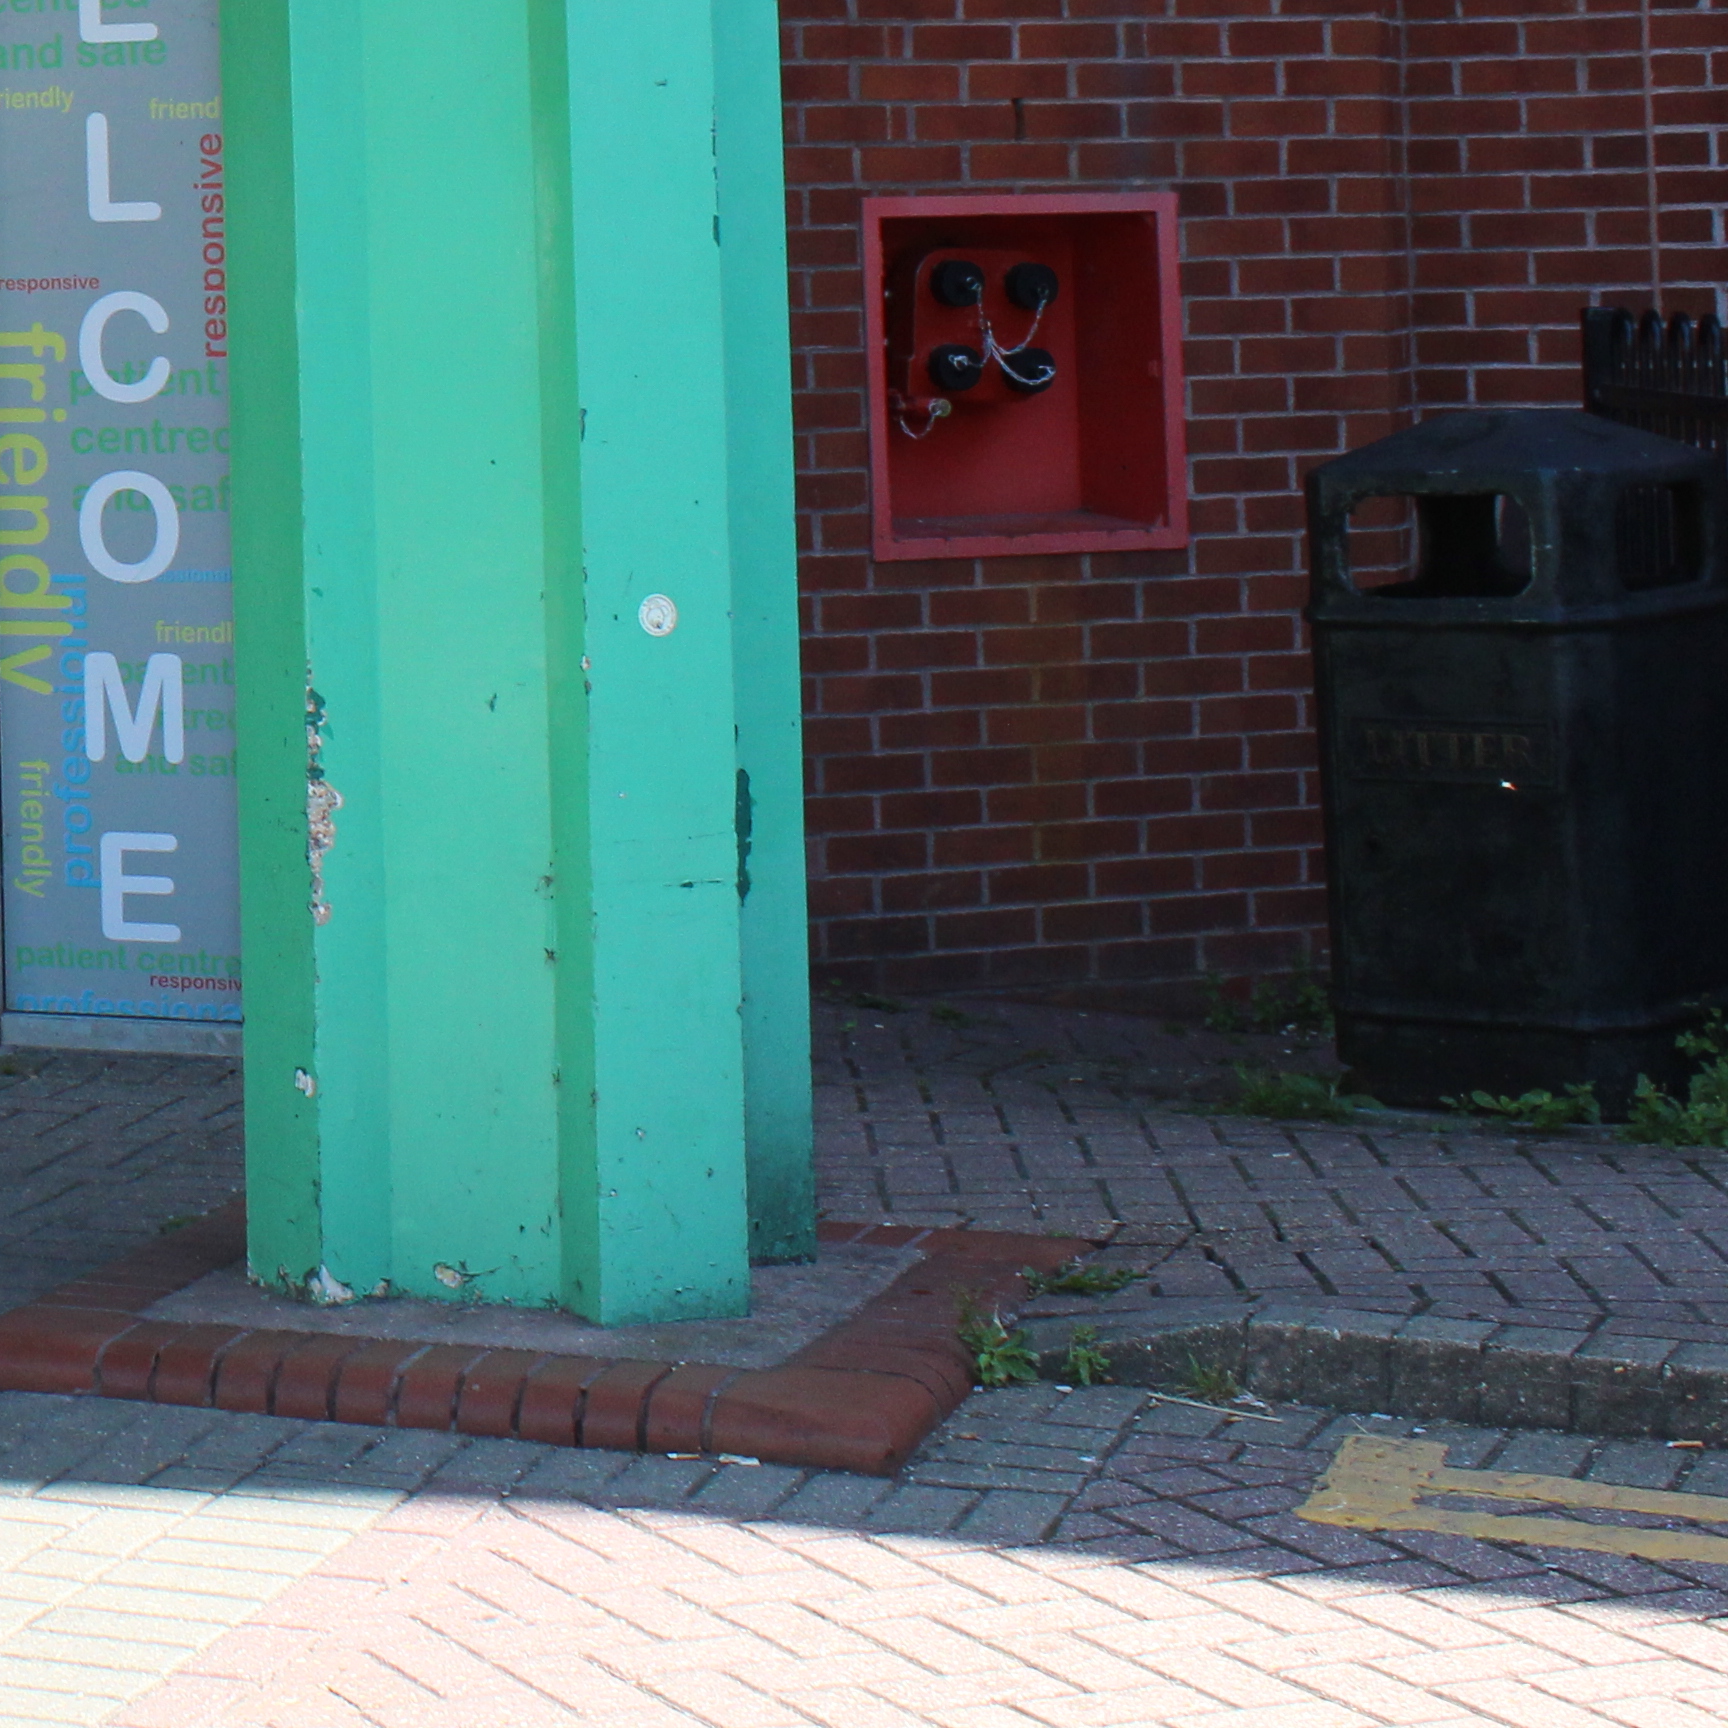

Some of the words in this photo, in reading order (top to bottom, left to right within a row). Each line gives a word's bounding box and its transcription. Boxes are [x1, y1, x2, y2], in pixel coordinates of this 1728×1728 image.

[194, 132, 227, 358] responsive
[1365, 729, 1535, 770] LITTER
[14, 758, 52, 898] friendly
[16, 941, 129, 972] patient
